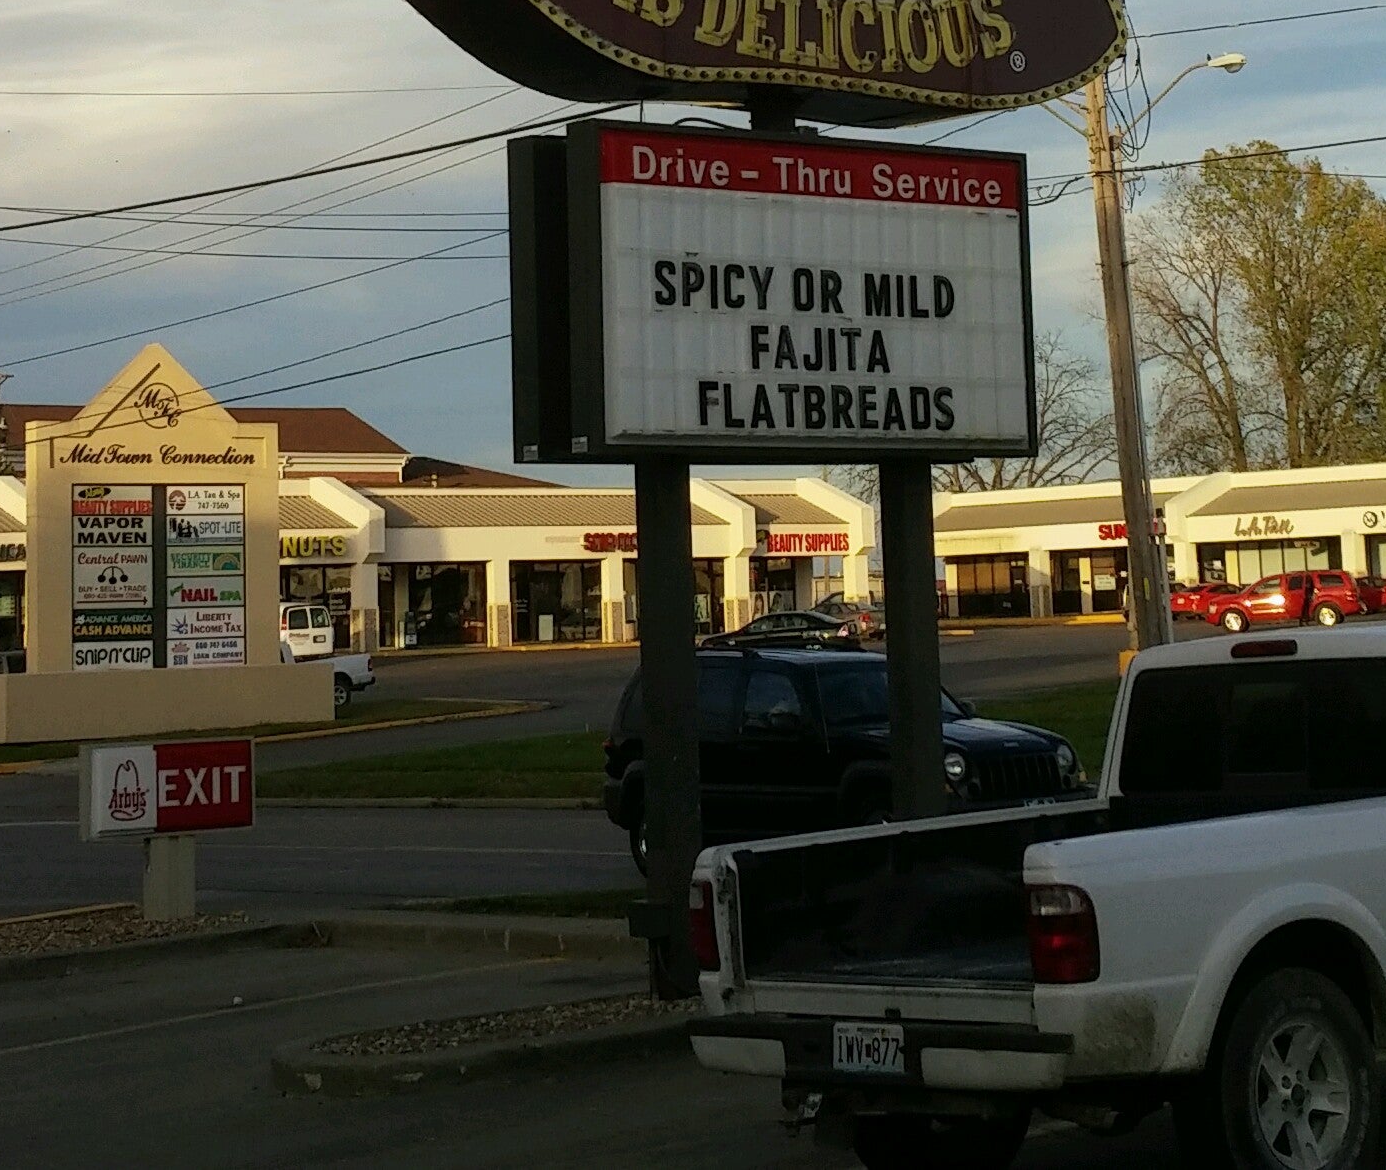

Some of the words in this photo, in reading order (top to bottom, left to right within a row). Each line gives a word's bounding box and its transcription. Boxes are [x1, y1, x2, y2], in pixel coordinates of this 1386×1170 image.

[632, 146, 729, 186] Drive
[772, 156, 851, 195] Thru
[873, 163, 1002, 205] Service
[654, 260, 773, 310] SPICY
[793, 268, 843, 314] OR
[864, 273, 955, 318] MILD
[751, 325, 890, 373] FAJITA
[699, 380, 955, 431] FLATBREADS
[160, 444, 255, 465] Connection
[204, 491, 216, 499] Tan
[219, 491, 225, 499] &
[227, 491, 241, 500] Spa
[78, 517, 143, 529] VAPOR
[78, 532, 147, 544] MAVEN
[767, 534, 803, 552] BEAUTY
[804, 533, 850, 552] SUPPLIES
[77, 552, 121, 565] Central
[121, 554, 148, 564] PAWN
[181, 588, 218, 603] NAIL
[220, 591, 242, 601] SPA
[86, 615, 119, 624] ADVANCE
[121, 614, 153, 623] AMERICA
[196, 611, 232, 622] LIBERTY
[74, 625, 102, 636] CASH
[104, 623, 153, 636] ADVANCE
[190, 623, 223, 634] INCOME
[225, 622, 243, 633] TAX
[212, 652, 243, 660] COMPANY
[157, 766, 247, 808] EXIT
[109, 788, 148, 812] Arby's
